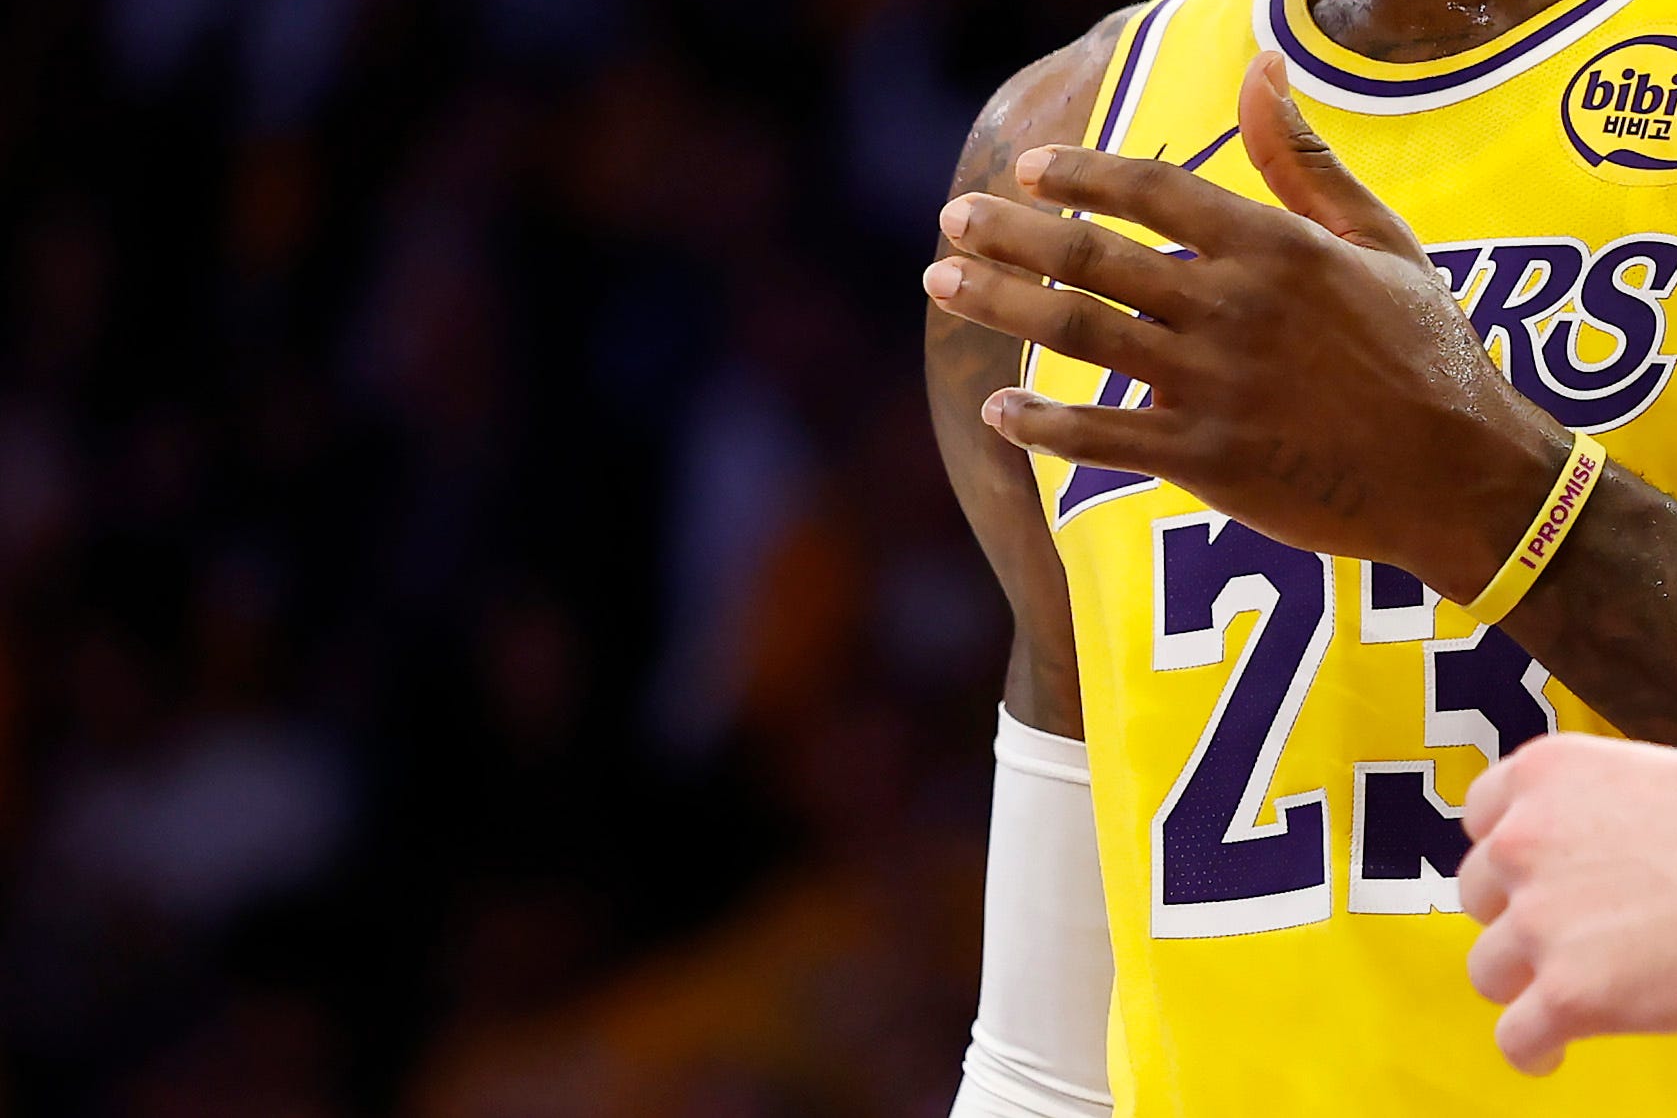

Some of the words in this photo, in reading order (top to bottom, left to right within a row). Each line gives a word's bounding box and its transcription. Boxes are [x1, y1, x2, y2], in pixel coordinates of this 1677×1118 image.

[1603, 115, 1672, 140] 비비고
[1519, 555, 1537, 570] I
[1528, 453, 1596, 558] PROMISE
[1152, 510, 1558, 939] 23
